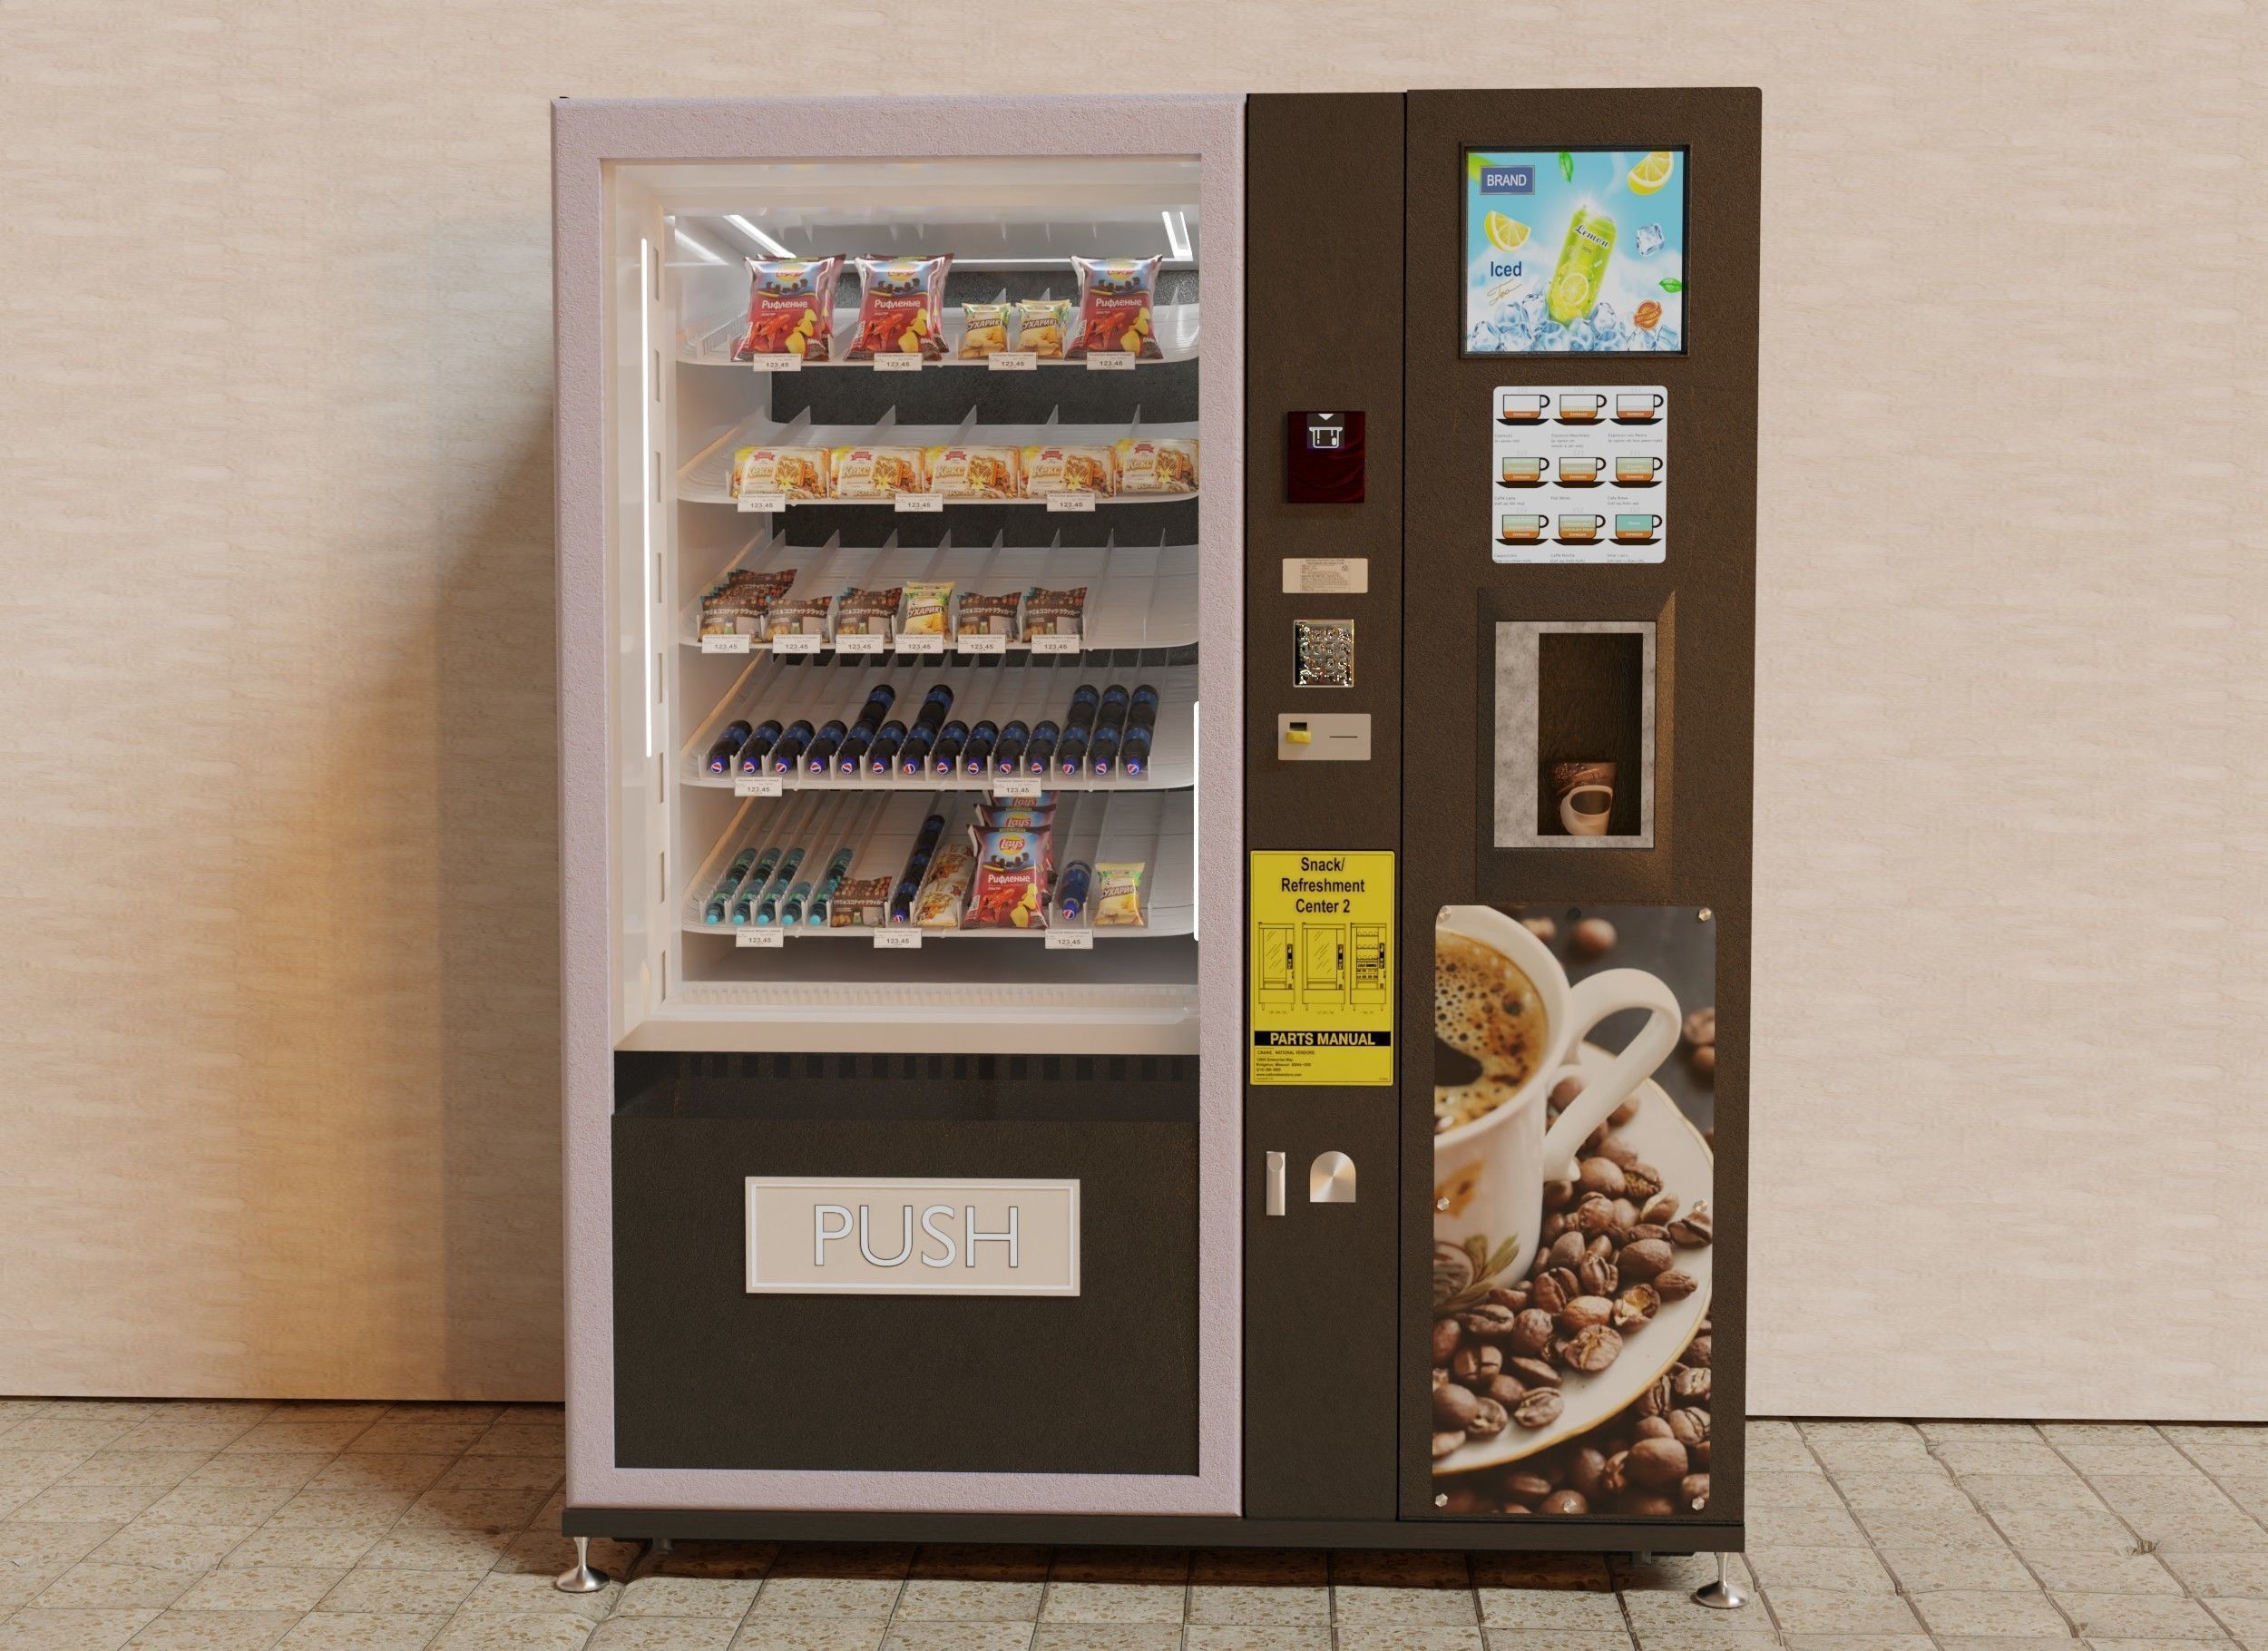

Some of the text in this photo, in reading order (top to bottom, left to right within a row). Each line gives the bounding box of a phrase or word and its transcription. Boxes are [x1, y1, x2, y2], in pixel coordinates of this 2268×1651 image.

[1487, 174, 1527, 187] BRAND
[1576, 225, 1608, 247] Lemon
[1491, 261, 1521, 277] Iced
[1487, 278, 1522, 306] Tea
[761, 300, 808, 309] Рифленые
[874, 299, 921, 309] Рифленые
[1095, 298, 1142, 308] Рифленые
[1301, 857, 1345, 872] Snack/
[988, 874, 1031, 884] Рифленые
[1281, 878, 1365, 893] Refreshment
[1295, 899, 1351, 913] Center 2
[1270, 1032, 1376, 1045] PARTS MANUAL
[814, 1204, 1019, 1268] PUSH
